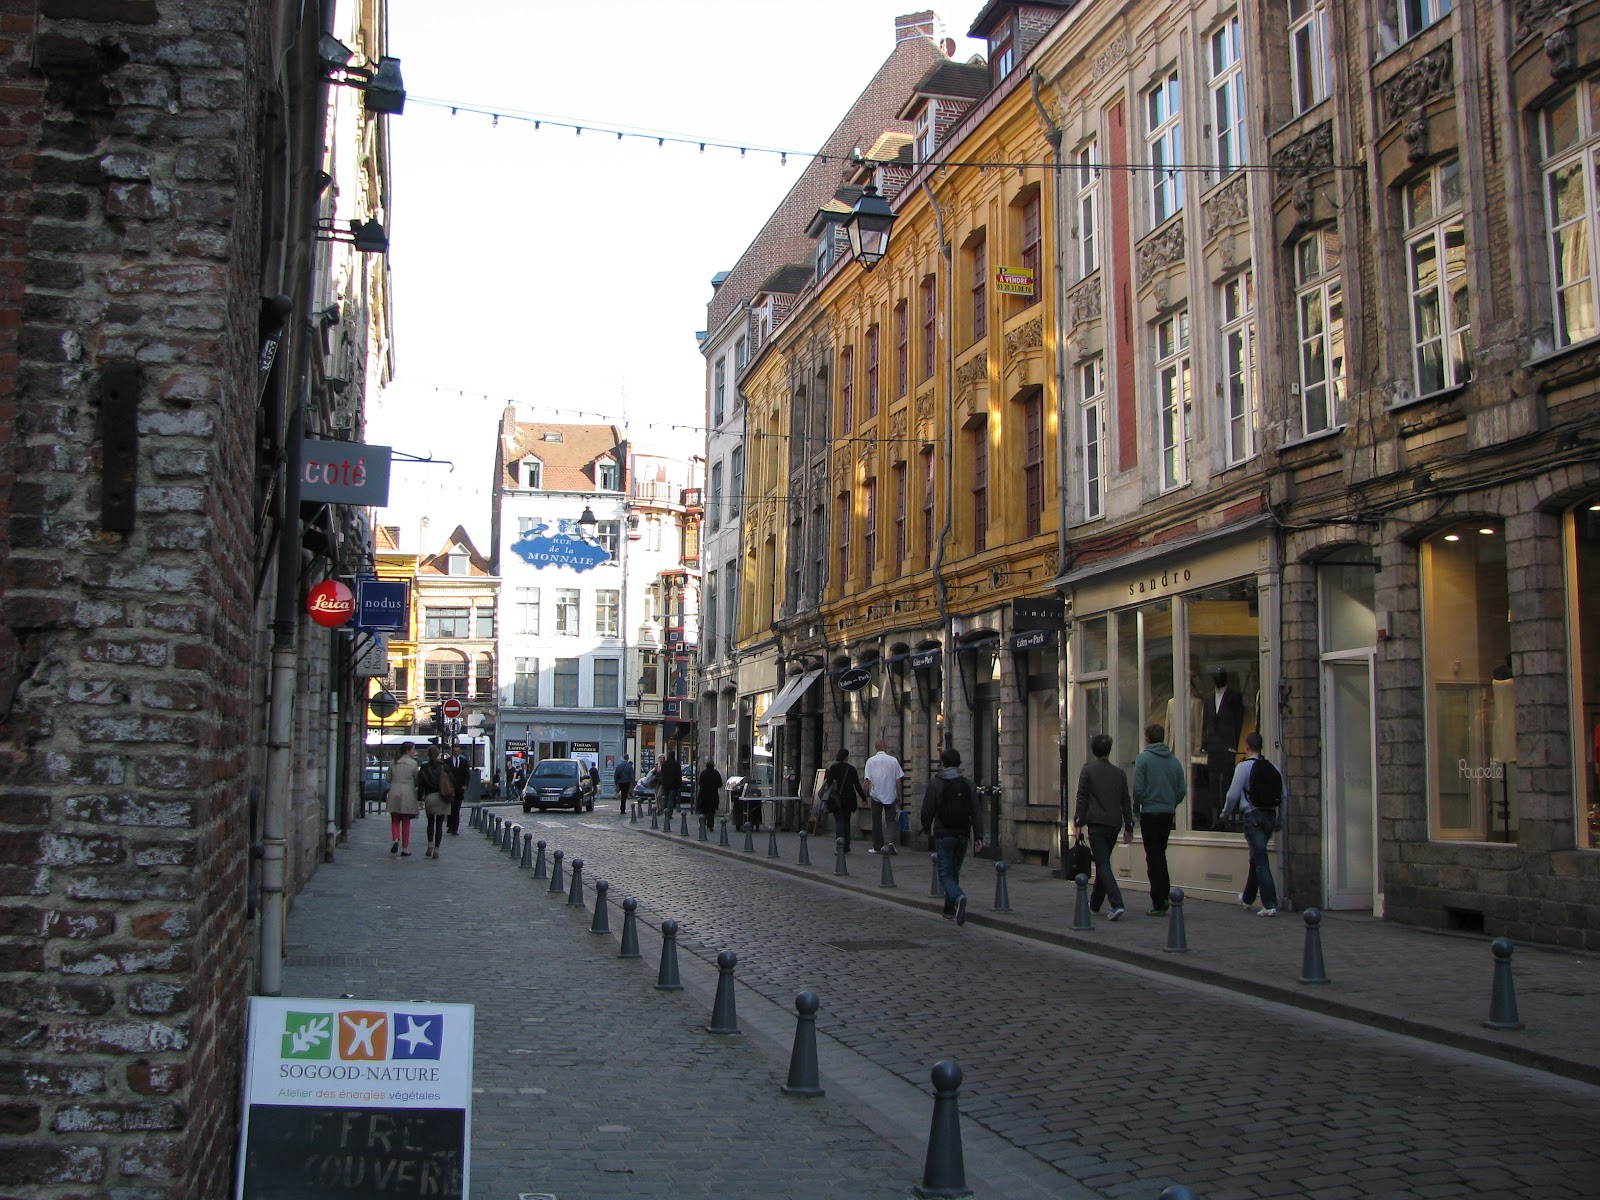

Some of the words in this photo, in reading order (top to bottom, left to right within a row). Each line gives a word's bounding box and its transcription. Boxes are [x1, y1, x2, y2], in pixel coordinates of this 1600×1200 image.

[1005, 276, 1028, 285] VENDRE
[305, 457, 367, 487] coté
[565, 546, 574, 554] la
[528, 552, 594, 565] MONNAIE
[1129, 569, 1191, 596] sandro
[311, 593, 351, 612] Leica
[365, 597, 402, 609] nodus
[1015, 610, 1063, 618] sandro
[1016, 638, 1028, 648] Eden
[1033, 633, 1044, 645] Park
[858, 673, 870, 682] Park
[1458, 757, 1504, 785] Poupette
[279, 1063, 440, 1082] SOGOOD-NATURE
[278, 1088, 312, 1098] Atelier
[315, 1089, 336, 1099] des
[339, 1089, 386, 1101] énergies
[389, 1091, 441, 1101] végétales
